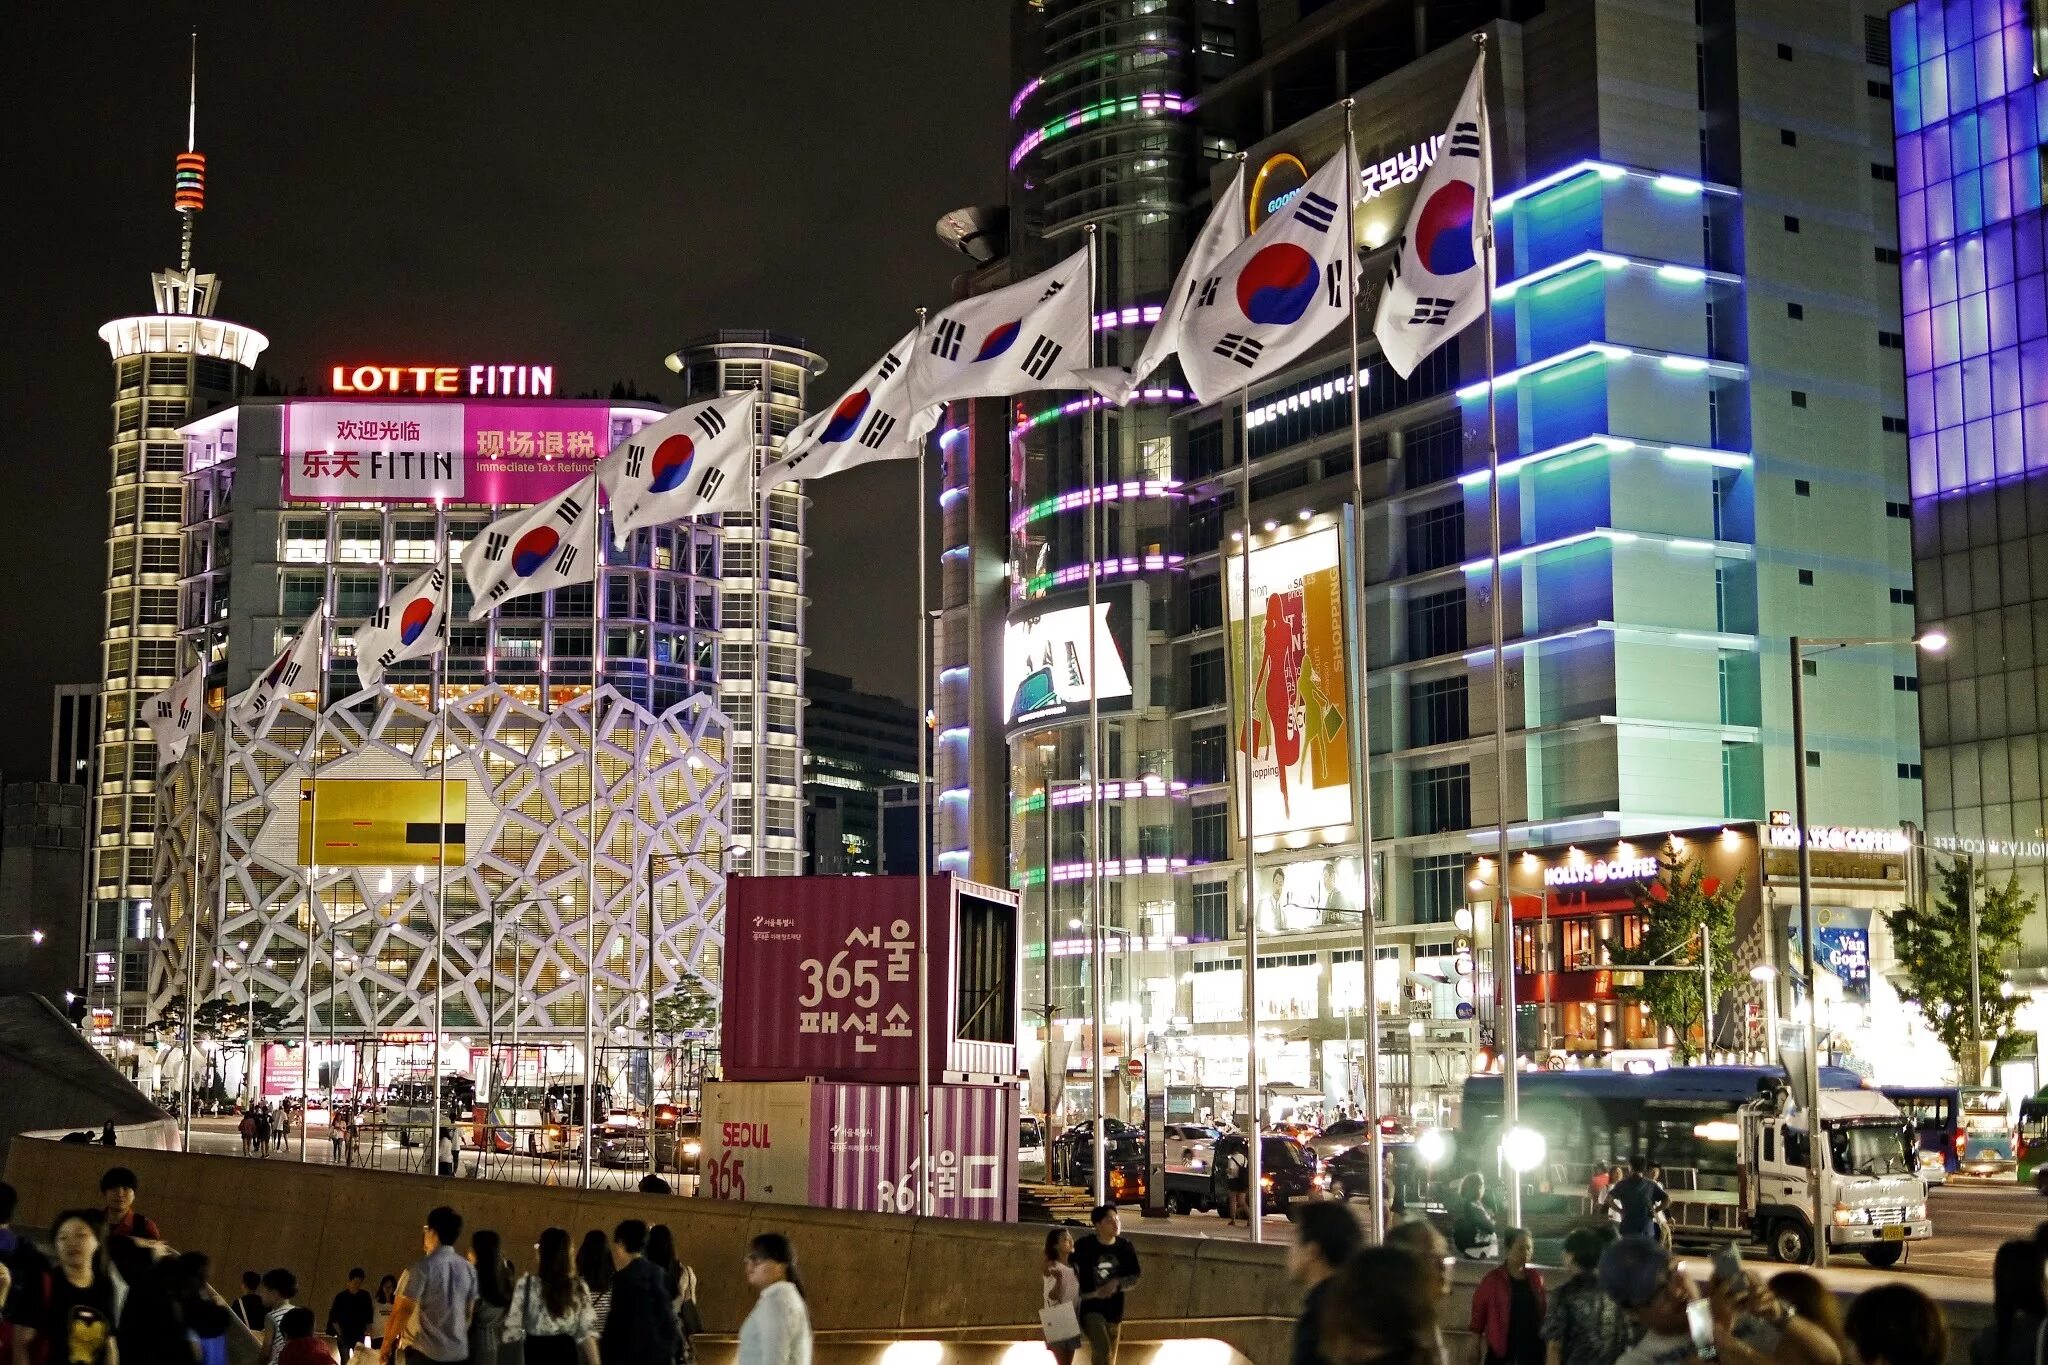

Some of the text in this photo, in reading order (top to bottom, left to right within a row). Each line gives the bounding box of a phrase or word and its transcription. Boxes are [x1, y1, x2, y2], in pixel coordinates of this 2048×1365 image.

[1360, 134, 1447, 203] 굿모닝시
[332, 365, 553, 395] LOTTE FITIN
[337, 420, 421, 441] 欢迎光临
[476, 430, 596, 458] 现场退税
[302, 450, 453, 480] 乐天 FITIN
[476, 462, 535, 473] Immediate
[537, 462, 556, 473] Tax
[1328, 567, 1344, 673] SHOPPING
[844, 919, 916, 982] 서울
[1839, 935, 1866, 951] Van
[1829, 950, 1867, 969] Gogh
[798, 950, 881, 1009] 365
[799, 1002, 914, 1053] 패션쇼
[722, 1122, 771, 1149] SEOUL
